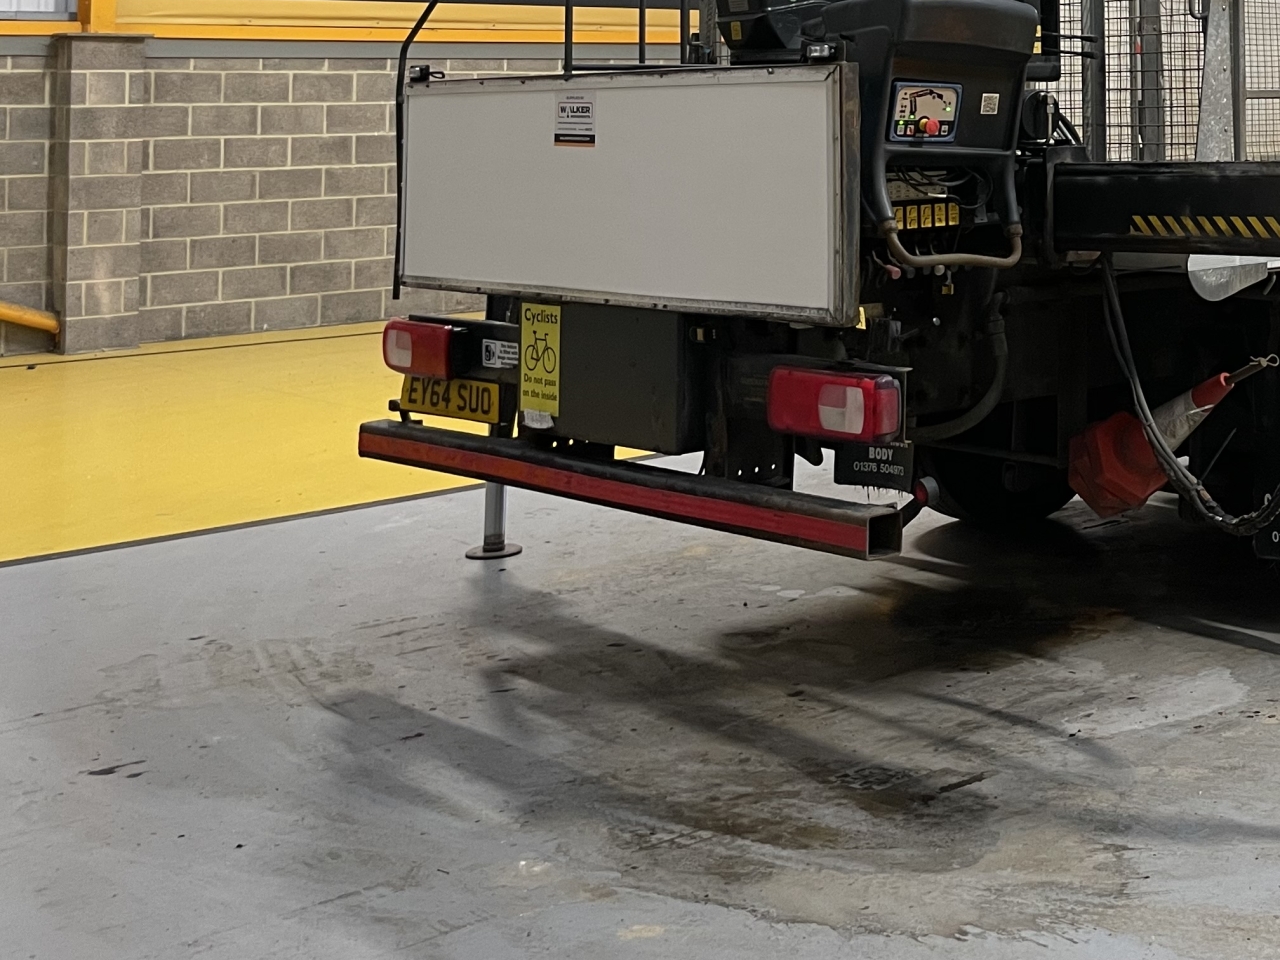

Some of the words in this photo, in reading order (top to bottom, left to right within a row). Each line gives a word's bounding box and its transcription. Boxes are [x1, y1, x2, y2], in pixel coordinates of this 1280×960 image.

[560, 106, 591, 118] WALKER
[524, 308, 558, 326] Cyclists
[523, 373, 533, 382] Do
[533, 375, 543, 385] not
[544, 378, 557, 388] pass
[408, 376, 452, 409] EY64
[522, 389, 530, 397] on
[530, 389, 540, 399] the
[540, 390, 558, 401] inside
[868, 447, 893, 460] BODY
[853, 461, 877, 472] 01376
[880, 463, 904, 475] 504973
